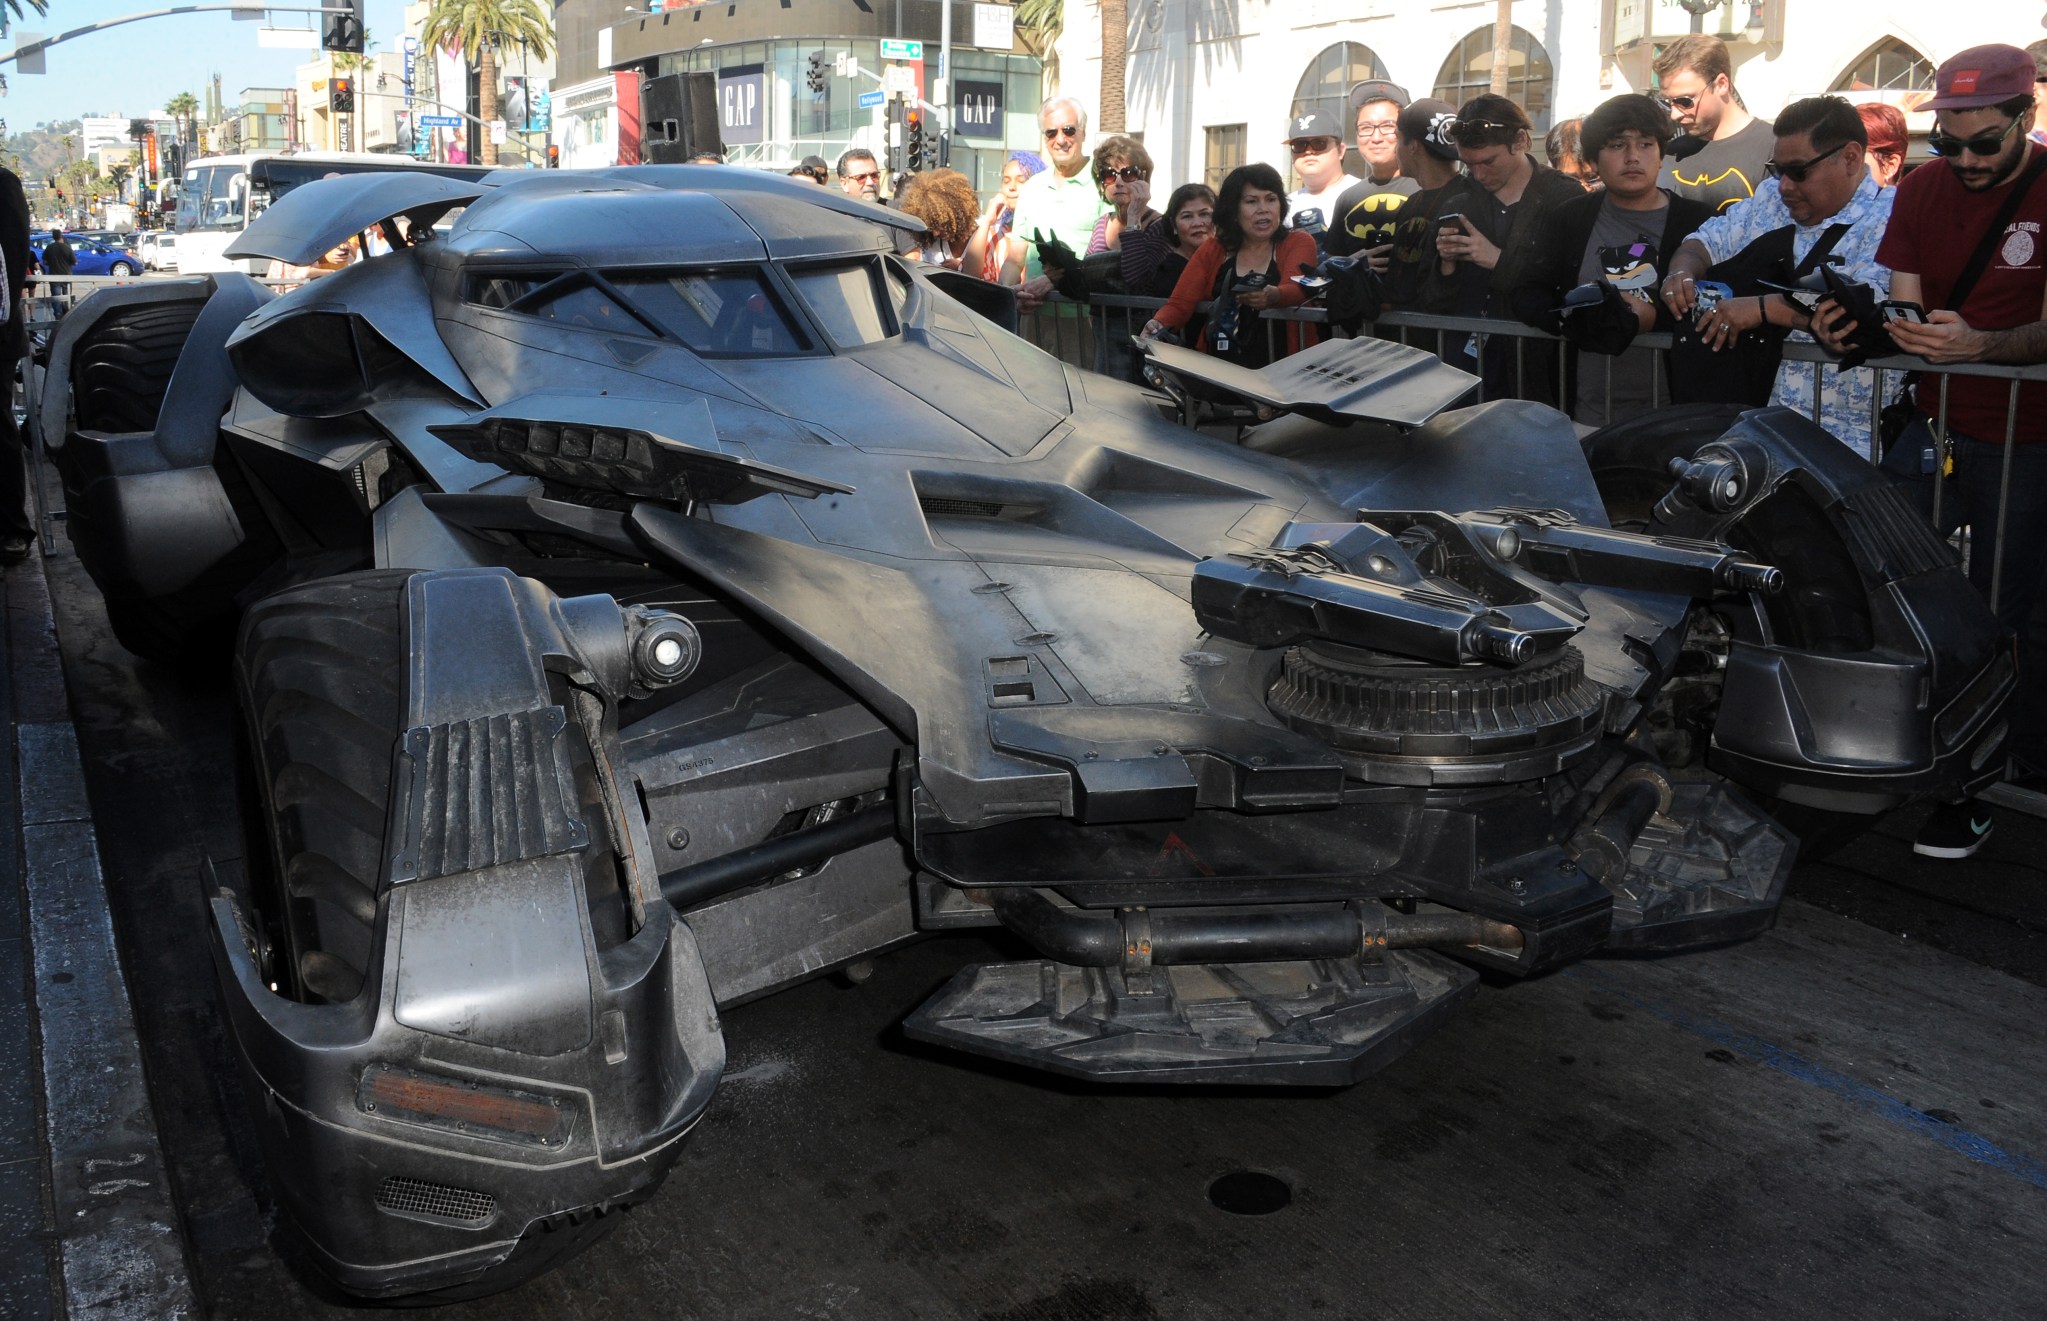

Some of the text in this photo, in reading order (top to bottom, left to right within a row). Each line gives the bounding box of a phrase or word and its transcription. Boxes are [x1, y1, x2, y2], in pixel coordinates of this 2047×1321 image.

[725, 83, 755, 127] GAP
[963, 93, 996, 124] GAP
[423, 117, 449, 125] Highland
[340, 123, 348, 152] HEATRE
